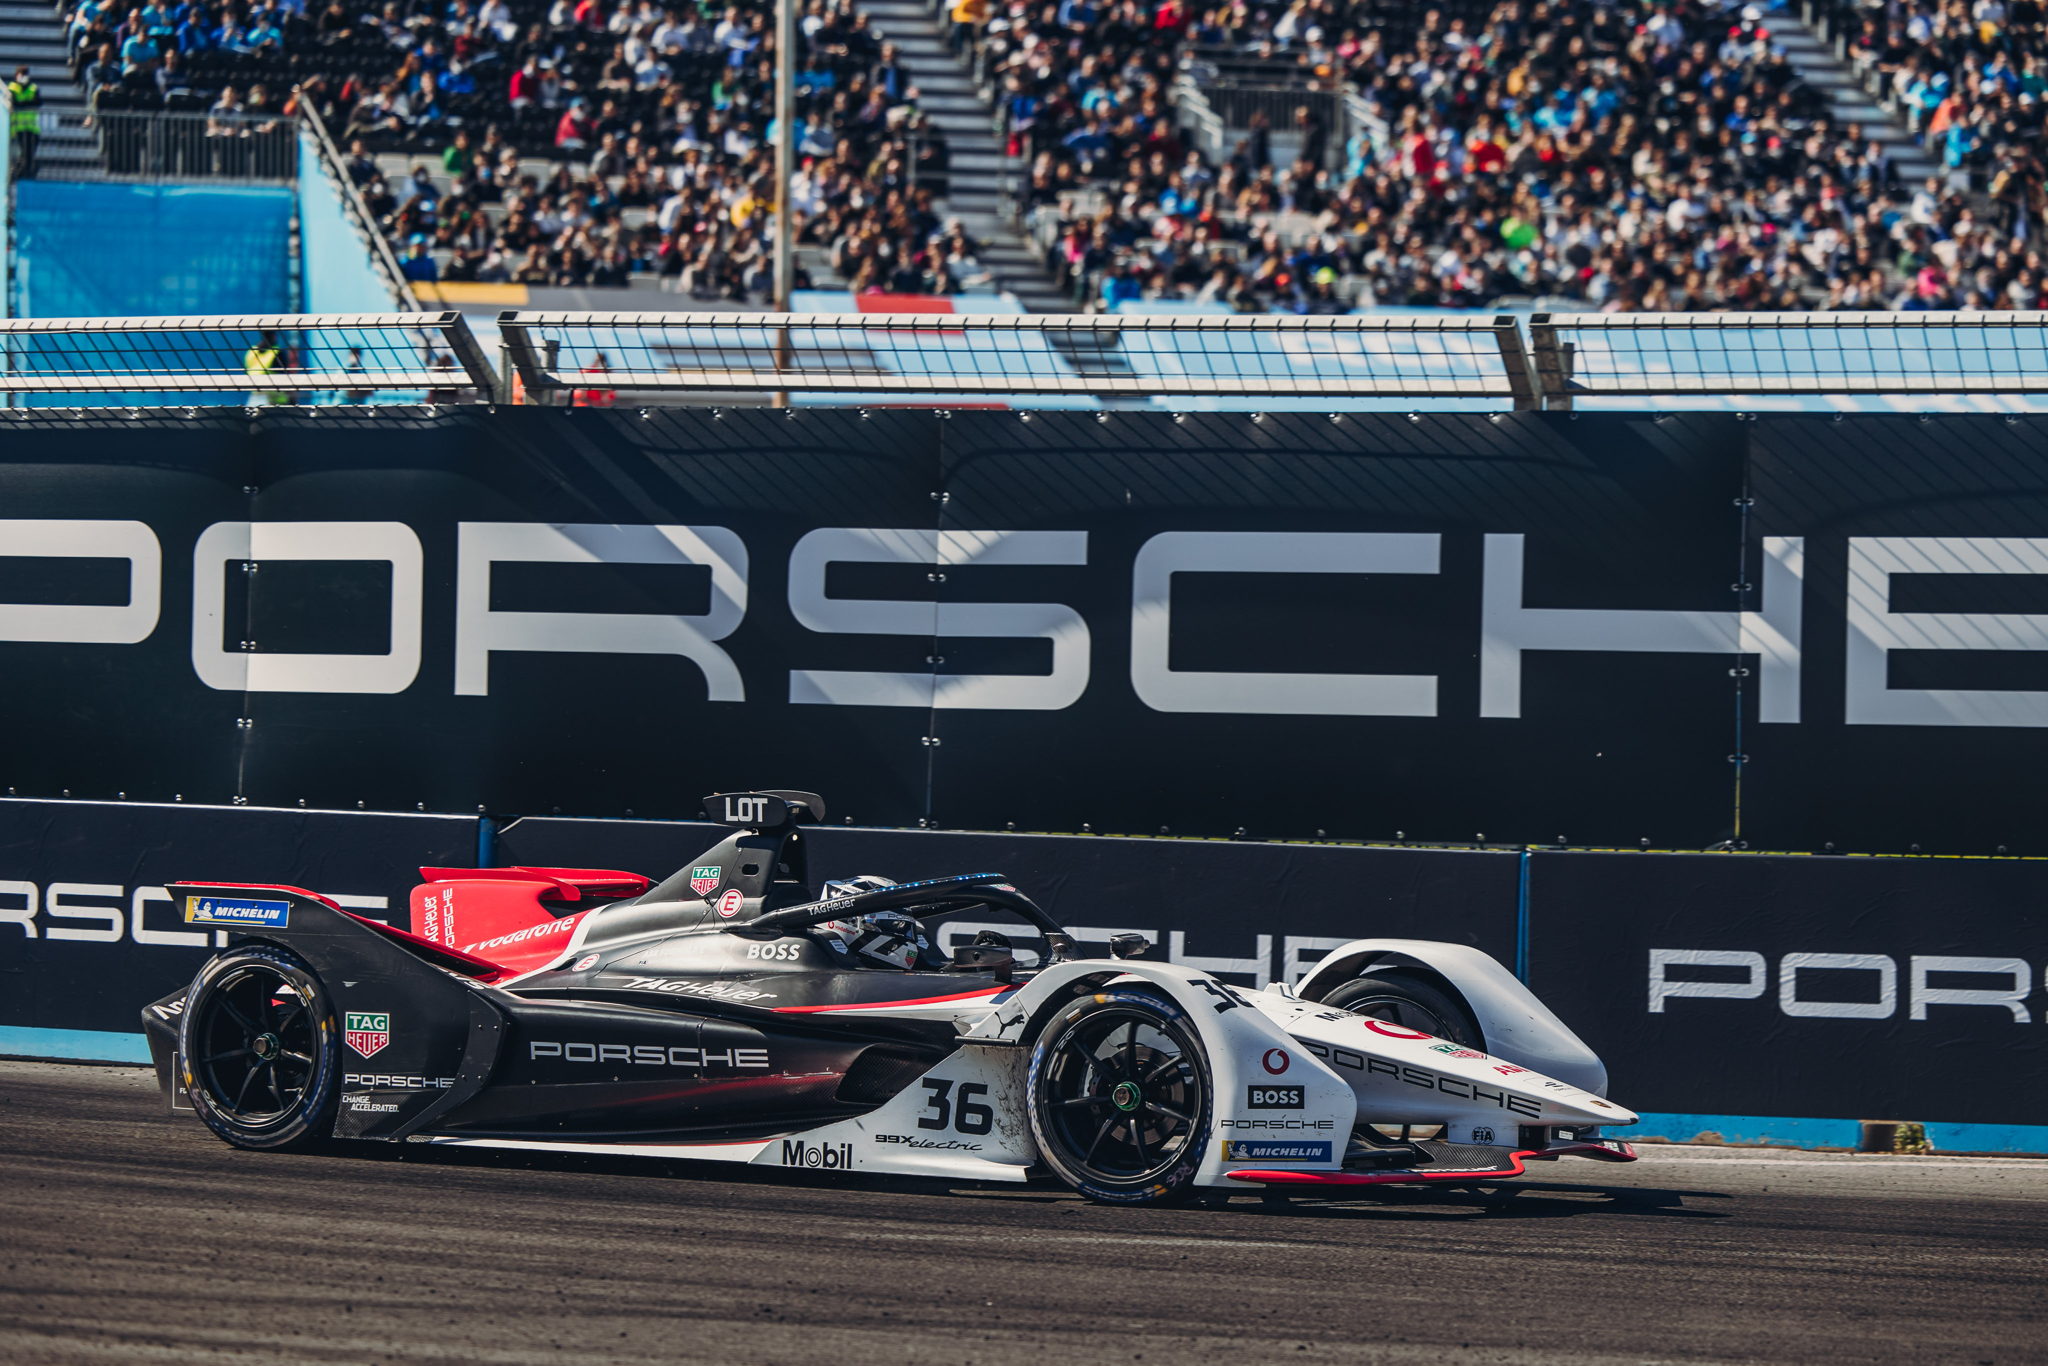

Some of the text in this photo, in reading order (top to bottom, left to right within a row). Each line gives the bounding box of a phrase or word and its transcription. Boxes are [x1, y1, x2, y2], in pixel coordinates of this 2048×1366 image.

[725, 797, 768, 822] LOT
[695, 868, 718, 877] TAG
[690, 879, 718, 895] HEUER
[214, 906, 280, 920] MICHELIN
[424, 896, 439, 942] AGHeuer
[475, 917, 575, 949] vodafone
[747, 943, 801, 961] BOSS
[1647, 948, 2048, 1023] POR
[349, 1015, 386, 1030] TAG
[348, 1032, 387, 1055] HEUER
[530, 1041, 770, 1068] PORSCHE
[344, 1073, 456, 1088] PORSCHE
[1252, 1090, 1299, 1104] BOSS
[918, 1077, 994, 1135] 36
[1220, 1120, 1335, 1130] PORSCHE
[908, 1137, 983, 1151] electric
[1473, 1130, 1494, 1144] FIA
[782, 1139, 853, 1169] Mobil
[1251, 1147, 1323, 1157] MICHELIN
